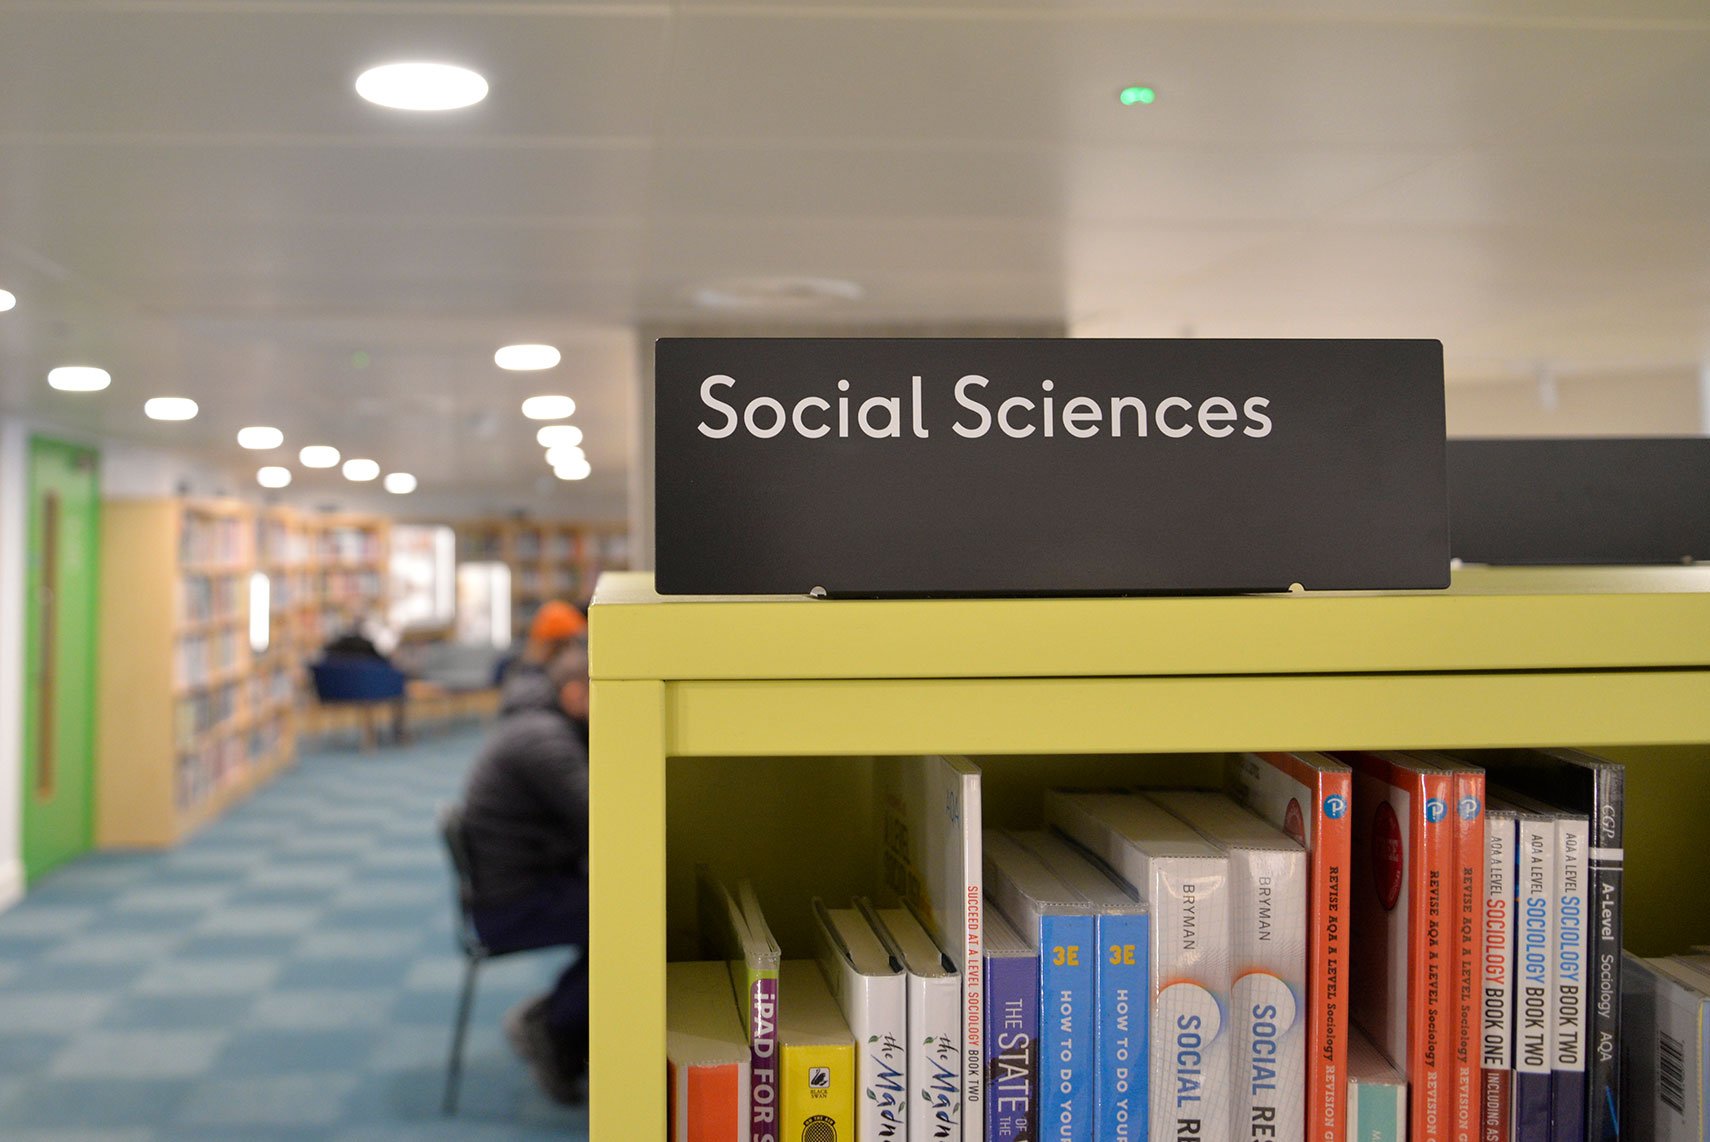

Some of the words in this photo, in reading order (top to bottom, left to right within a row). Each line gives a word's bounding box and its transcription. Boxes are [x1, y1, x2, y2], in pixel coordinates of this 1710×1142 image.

[697, 374, 928, 439] Social
[951, 374, 1273, 439] Sciences
[1602, 804, 1615, 839] CGP
[1491, 836, 1503, 857] AQA
[1531, 834, 1543, 855] AQA
[1531, 858, 1543, 866] A
[1566, 832, 1577, 853] AQA
[1329, 866, 1338, 911] REVISE
[1429, 870, 1439, 916] REVISE
[1463, 867, 1473, 913] REVISE
[1490, 869, 1502, 896] LEVEL
[1531, 867, 1543, 894] LEVEL
[1565, 865, 1577, 893] LEVEL
[968, 886, 978, 930] SUCCEED
[1182, 884, 1195, 951] BRYMAN
[1258, 876, 1271, 941] BRYMAN
[1326, 916, 1337, 941] AQA
[1602, 882, 1615, 941] A-Level
[968, 934, 978, 945] AT
[1328, 946, 1337, 954] A
[1427, 921, 1439, 946] AQA
[1460, 917, 1472, 943] AQA
[1486, 899, 1505, 985] SOCIOLOGY
[1526, 897, 1546, 984] SOCIOLOGY
[1560, 896, 1580, 982] SOCIOLOGY
[1053, 945, 1080, 966] 3E
[1109, 944, 1136, 965] 3E
[1429, 952, 1438, 960] A
[1462, 948, 1471, 956] A
[969, 959, 979, 988] LEVEL
[1328, 959, 1337, 1000] LEVEL
[1428, 964, 1438, 1006] LEVEL
[1461, 960, 1471, 1002] LEVEL
[1598, 954, 1614, 1018] Sociology
[753, 993, 775, 1059] iPAD
[968, 992, 979, 1046] SOCIOLOGY
[1005, 998, 1022, 1029] THE
[1060, 990, 1072, 1032] HOW
[1116, 989, 1128, 1031] HOW
[1485, 988, 1504, 1029] BOOK
[1525, 987, 1545, 1029] BOOK
[1559, 985, 1579, 1026] BOOK
[882, 1032, 904, 1059] the
[937, 1033, 959, 1060] the
[1060, 1038, 1072, 1062] TO
[1116, 1037, 1128, 1061] TO
[1252, 1004, 1277, 1096] SOCIAL
[1323, 1003, 1336, 1062] Sociology
[1425, 1009, 1438, 1068] Sociology
[1457, 1005, 1470, 1064] Sociology
[1484, 1035, 1503, 1066] ONE
[1524, 1034, 1544, 1067] TWO
[1558, 1031, 1578, 1064] TWO
[1597, 1032, 1613, 1062] AQA
[968, 1049, 979, 1075] BOOK
[998, 1033, 1029, 1112] STATE
[1060, 1069, 1072, 1094] DO
[1116, 1068, 1128, 1092] DO
[1177, 1014, 1201, 1108] SOCIAL
[753, 1068, 775, 1124] FOR
[871, 1054, 905, 1142] Madn
[926, 1056, 960, 1142] Madn
[968, 1081, 979, 1102] TWO
[1325, 1065, 1335, 1127] REVISION
[1427, 1071, 1438, 1134] REVISION
[1459, 1067, 1470, 1130] REVISION
[1486, 1072, 1500, 1126] INCLUDING
[999, 1116, 1011, 1136] THE
[1015, 1118, 1027, 1132] OF
[1252, 1106, 1276, 1142] RE
